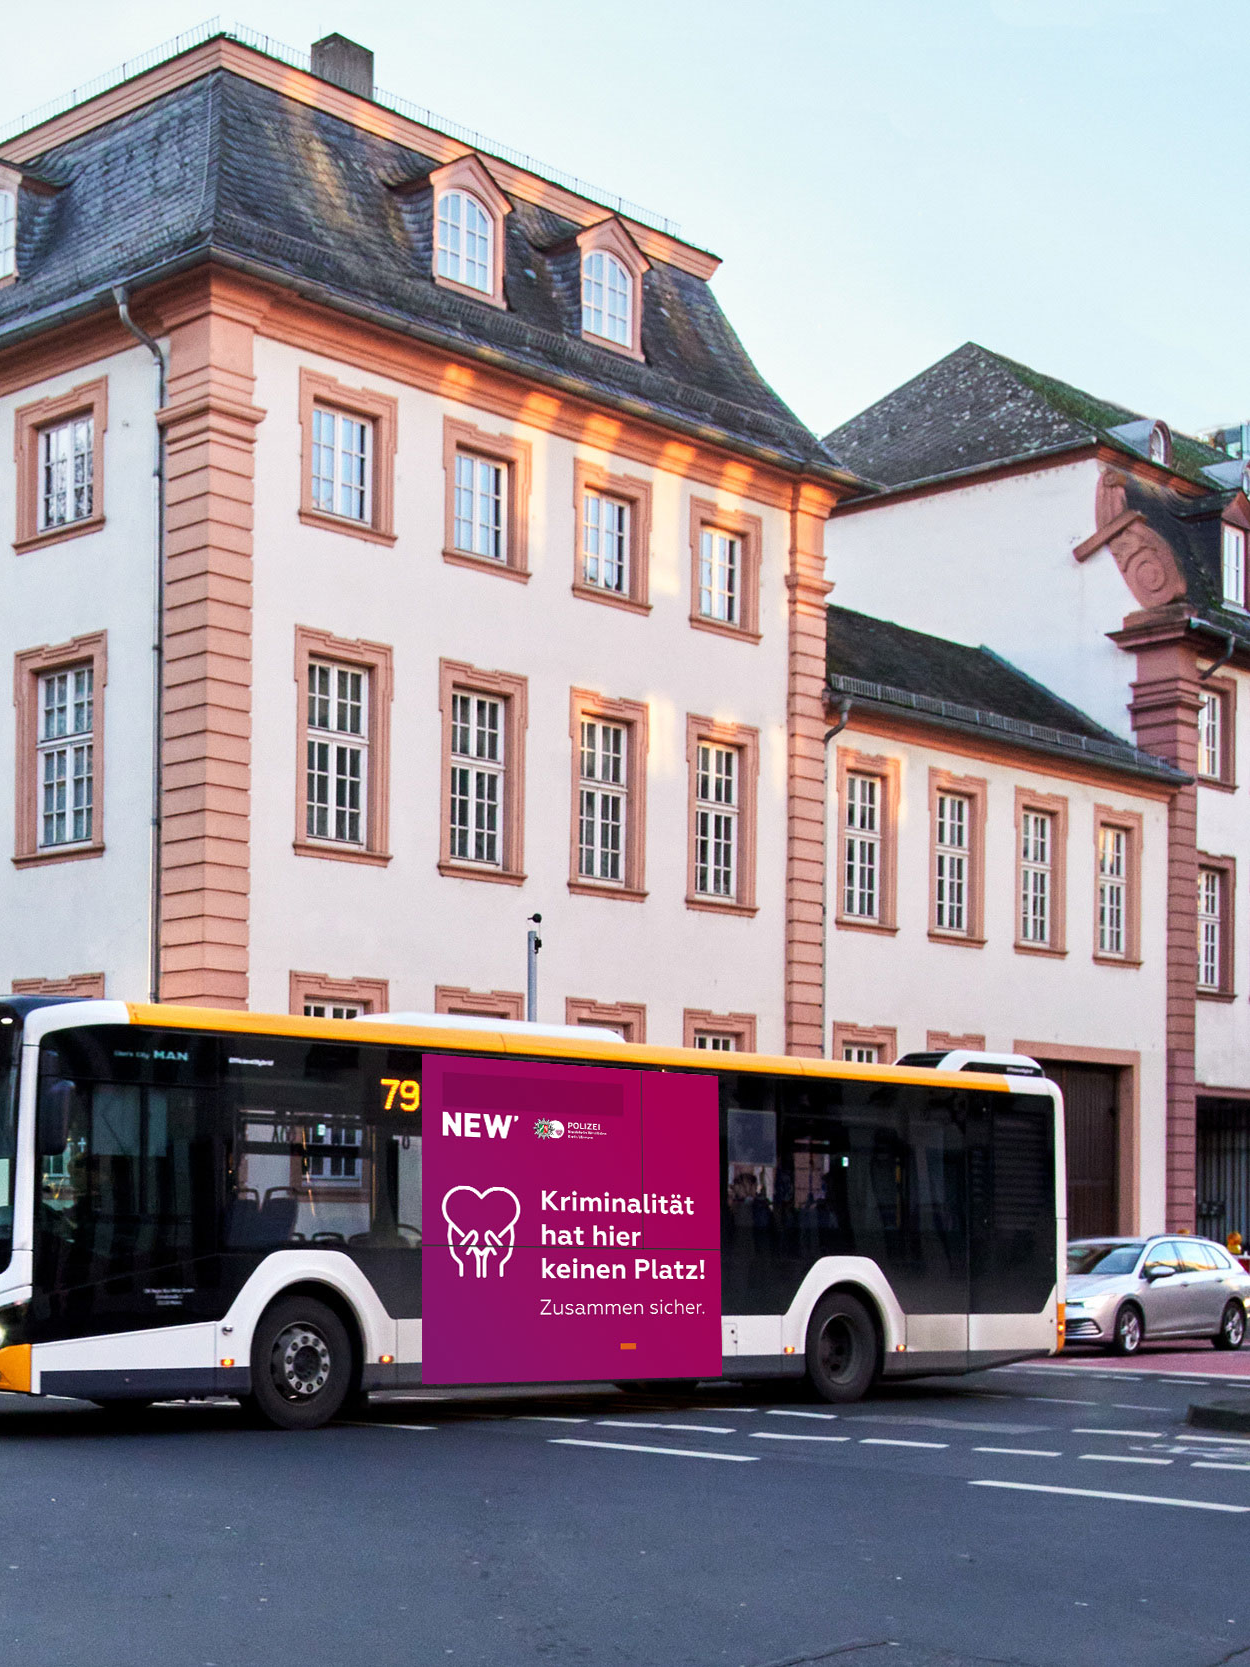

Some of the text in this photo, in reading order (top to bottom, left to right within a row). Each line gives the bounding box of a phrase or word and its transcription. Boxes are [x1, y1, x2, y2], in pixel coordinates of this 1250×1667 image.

[153, 1050, 189, 1062] MAN
[380, 1078, 421, 1112] 79
[567, 1121, 601, 1131] POLIZEI
[541, 1190, 695, 1215] Kriminalität
[541, 1223, 641, 1247] hat hier
[541, 1257, 705, 1280] keinen Platz!
[539, 1298, 706, 1316] Zusammen sicher.
